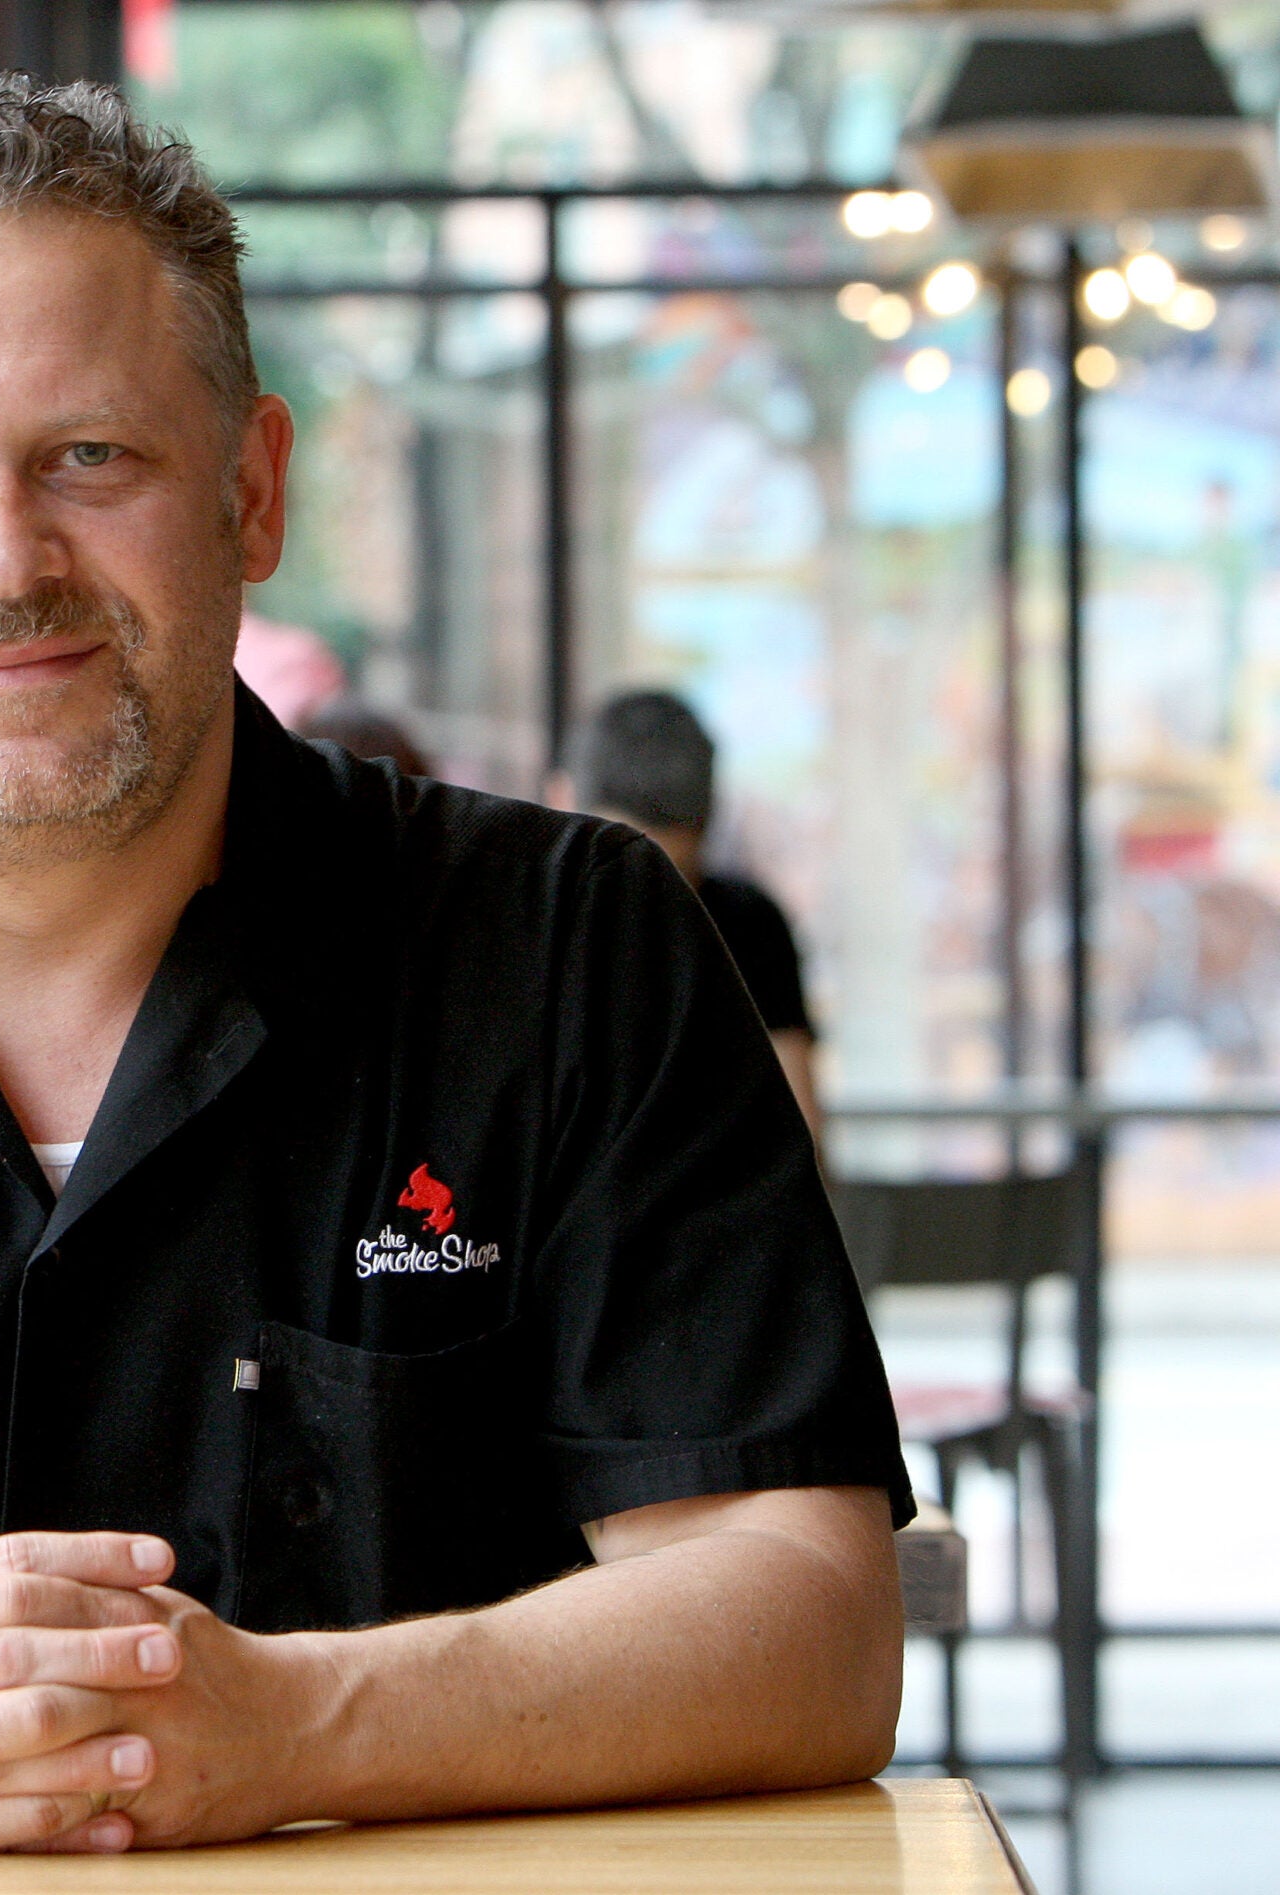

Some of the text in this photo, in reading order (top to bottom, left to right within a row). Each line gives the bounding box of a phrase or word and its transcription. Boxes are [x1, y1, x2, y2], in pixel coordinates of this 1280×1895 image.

[379, 1224, 408, 1248] the
[356, 1234, 501, 1278] Smoke Shop
